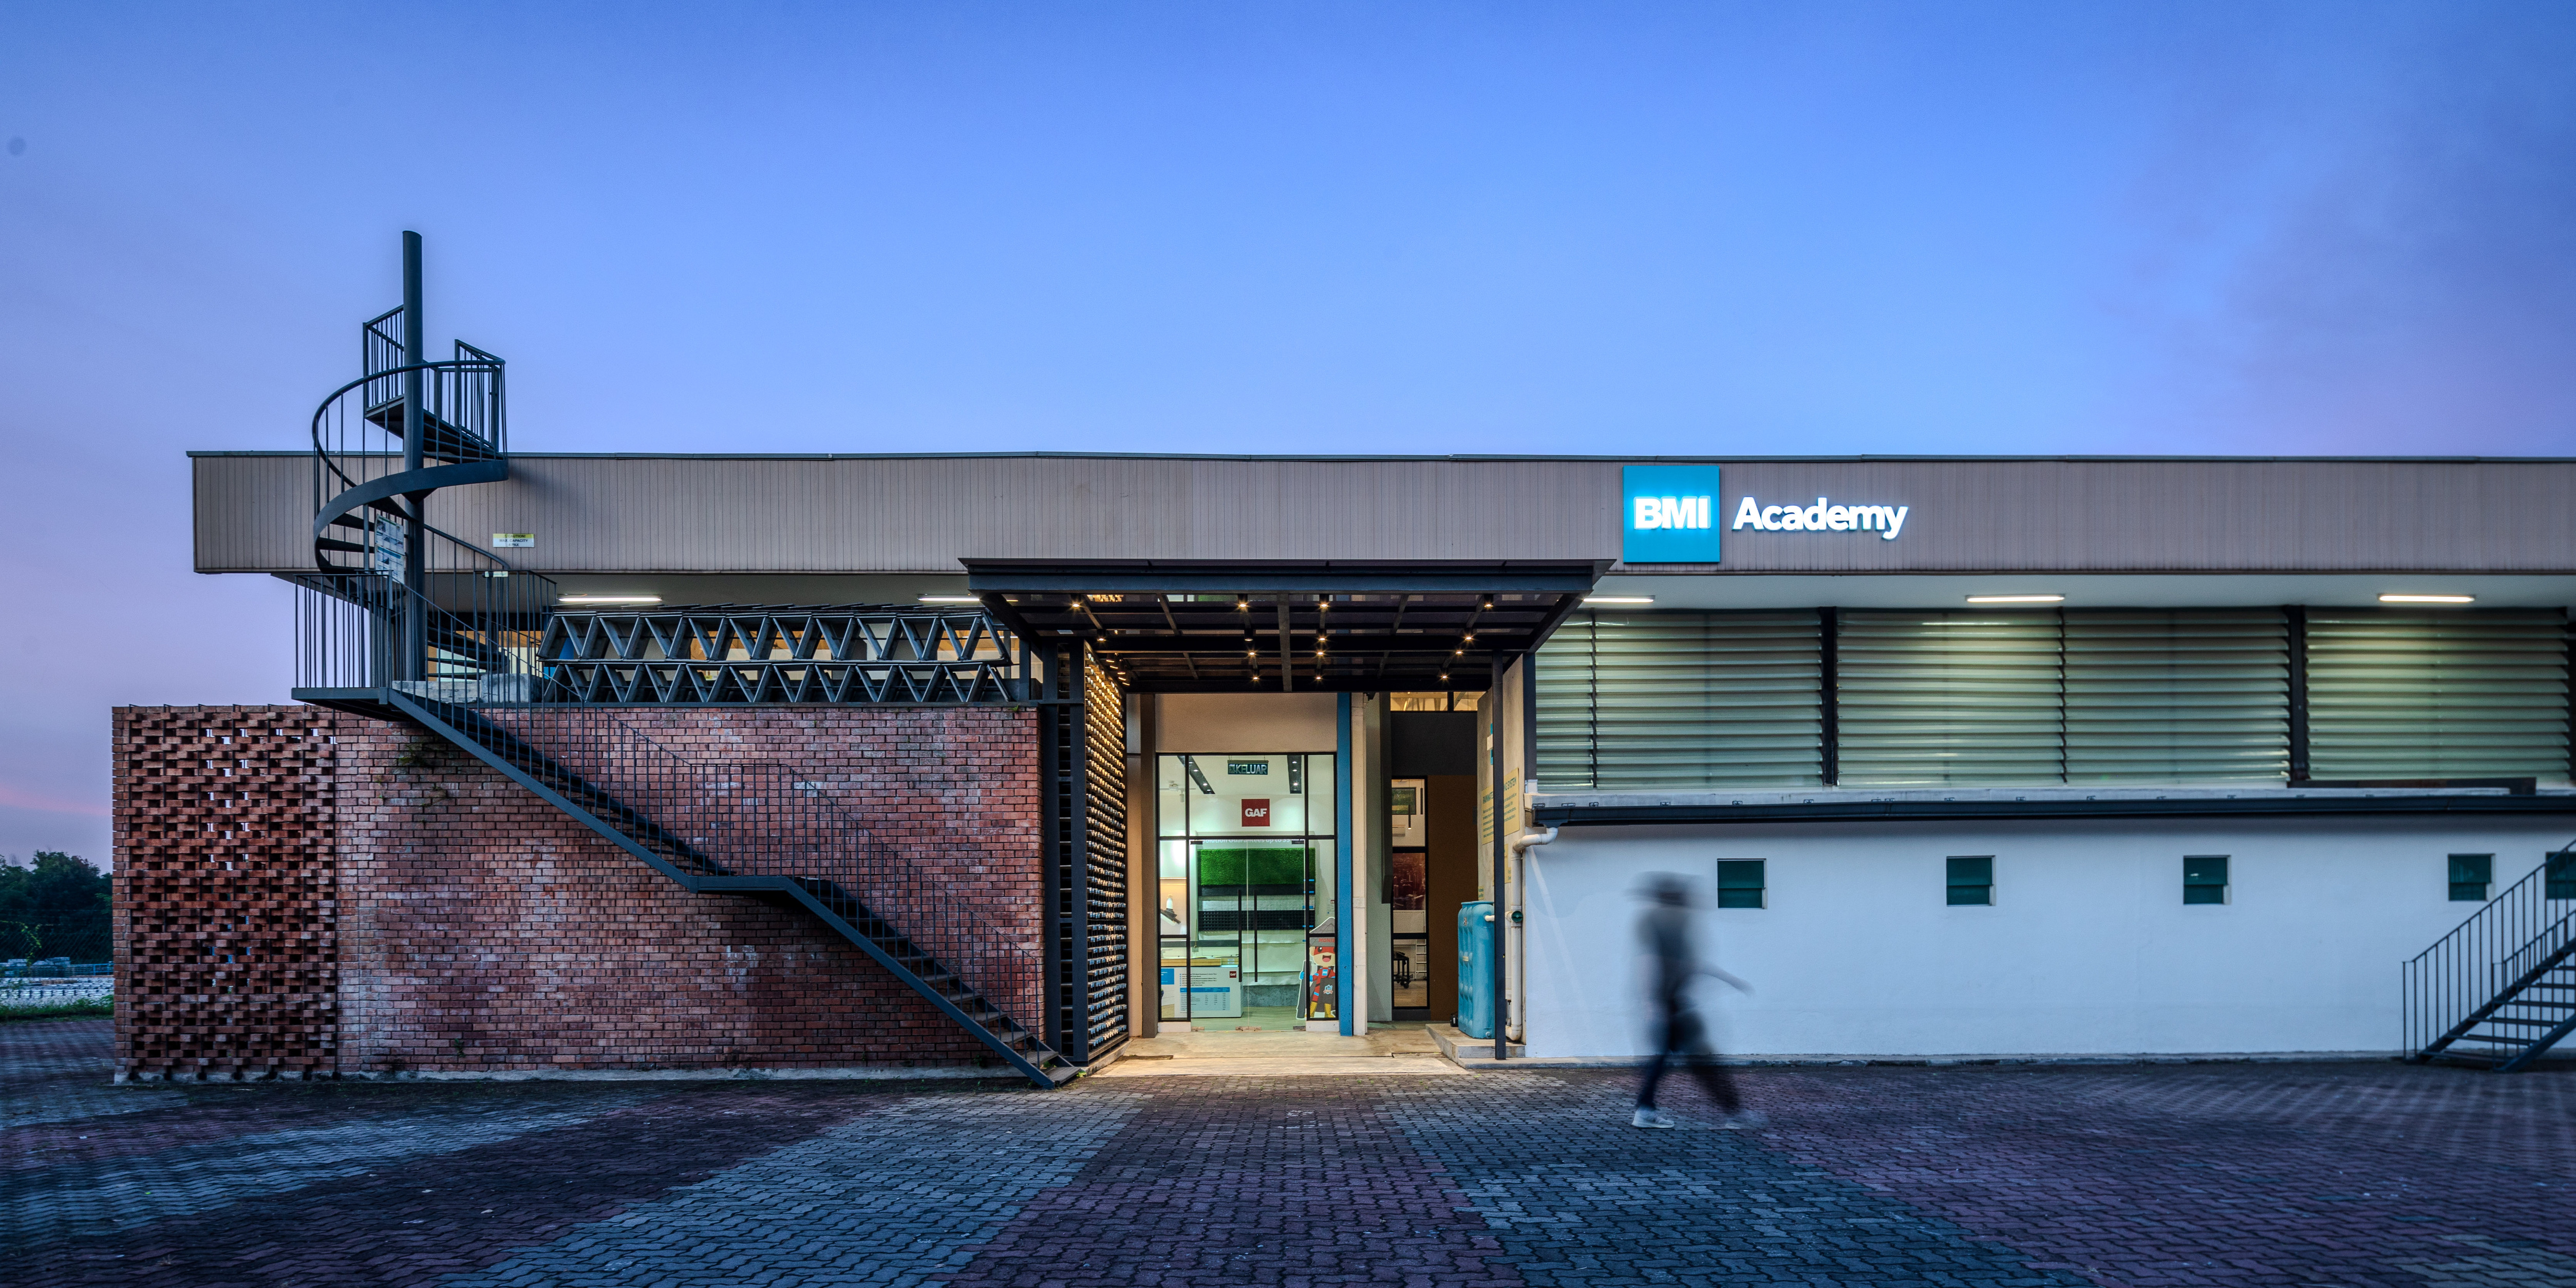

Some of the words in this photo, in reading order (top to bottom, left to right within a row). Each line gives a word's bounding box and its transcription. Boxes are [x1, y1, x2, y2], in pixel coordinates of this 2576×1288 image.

[1634, 496, 1710, 530] BMI
[1732, 497, 1908, 540] Academy
[1236, 764, 1267, 774] KELUAR
[1245, 808, 1267, 817] GAF
